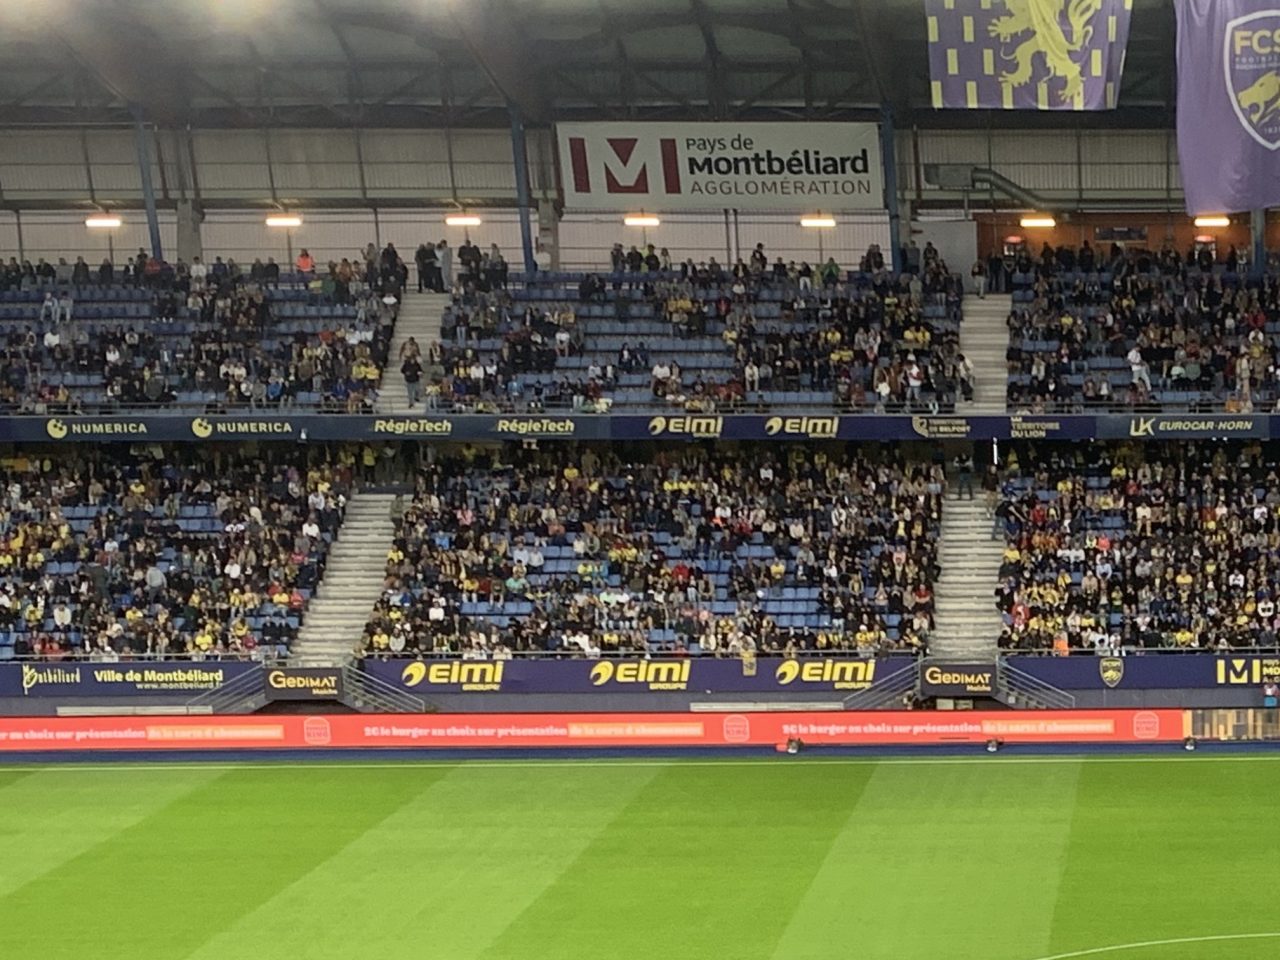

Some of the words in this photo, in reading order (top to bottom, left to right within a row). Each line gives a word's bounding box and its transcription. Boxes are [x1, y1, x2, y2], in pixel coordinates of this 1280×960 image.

[730, 133, 754, 150] de
[688, 148, 869, 176] Montbéliard
[691, 176, 872, 195] AGGLOMÉRATION
[72, 423, 148, 434] NUMERICA
[217, 422, 292, 433] NUMERICA
[374, 419, 452, 435] RégieTech
[497, 419, 575, 435] RégieTech
[94, 670, 123, 682] Ville
[125, 669, 142, 682] de
[144, 669, 223, 682] Montbéliard
[391, 726, 430, 738] burger
[809, 724, 847, 735] burger
